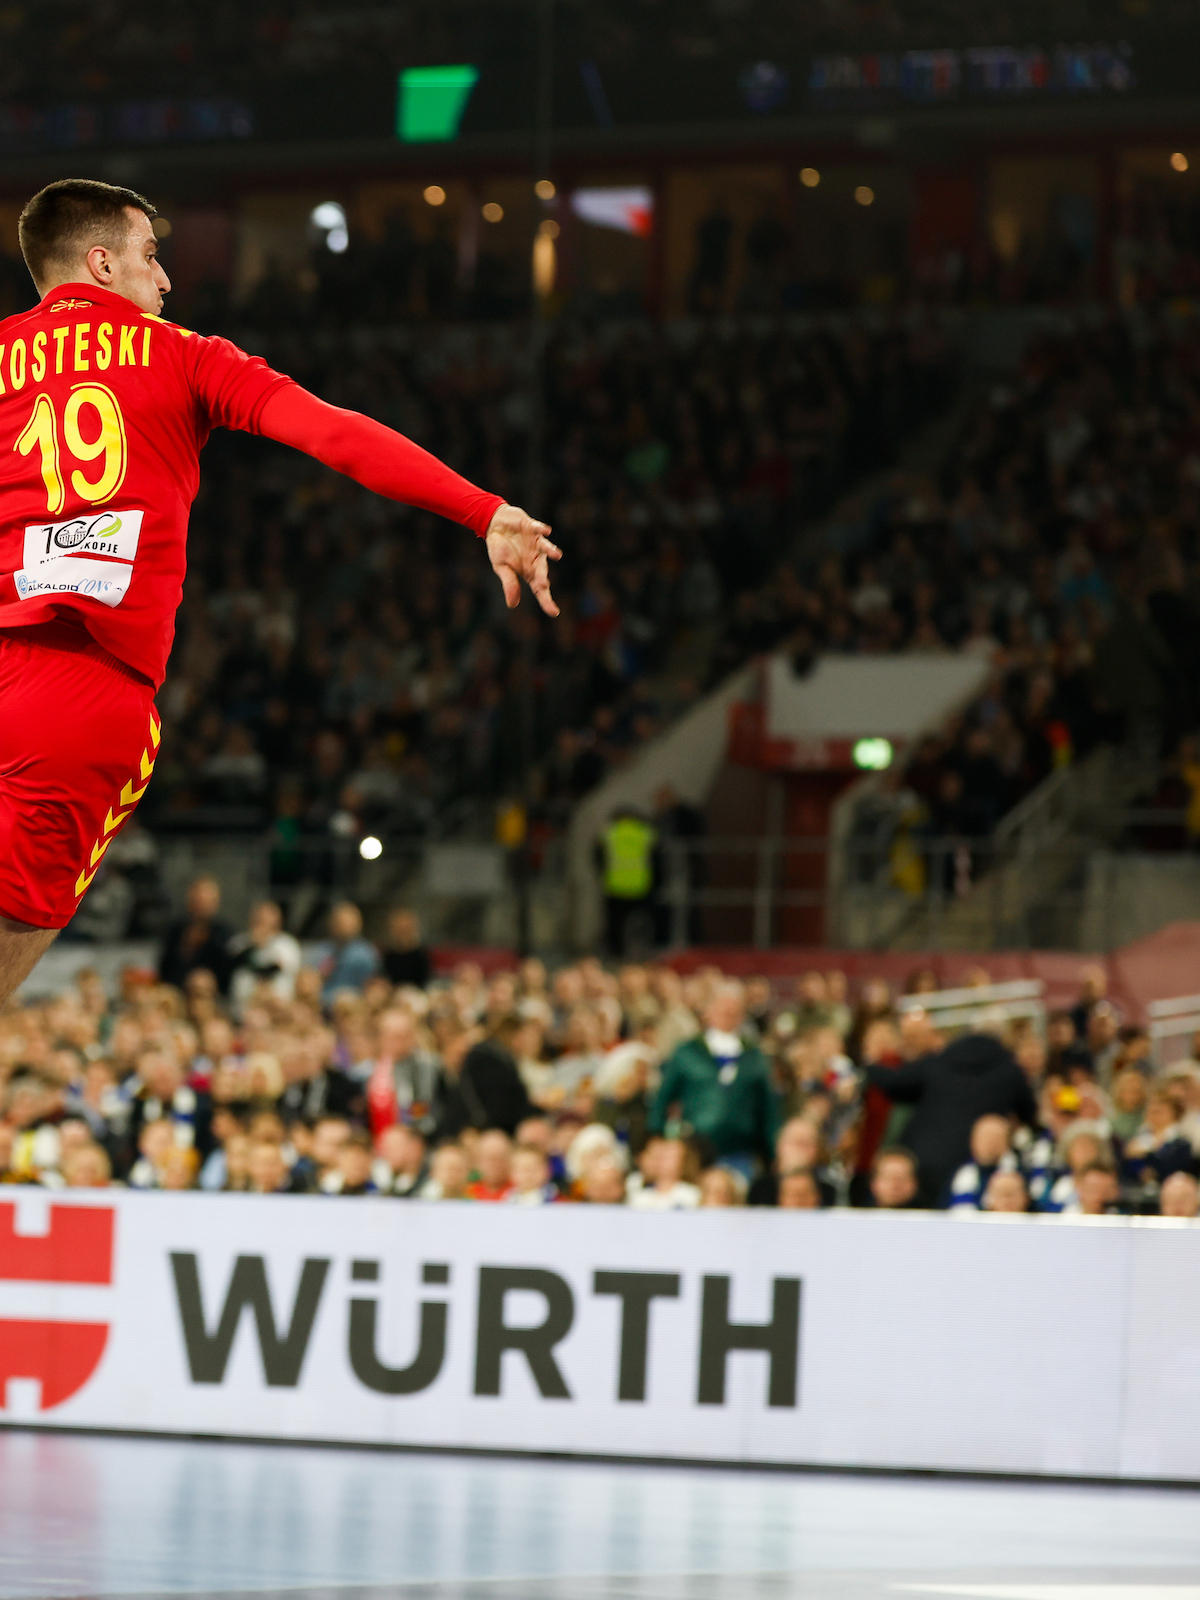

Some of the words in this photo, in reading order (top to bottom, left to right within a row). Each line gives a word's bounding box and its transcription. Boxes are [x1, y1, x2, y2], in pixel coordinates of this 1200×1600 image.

[13, 381, 128, 515] 19
[28, 583, 78, 591] ALKALOID
[169, 1250, 804, 1408] WÜRTH
